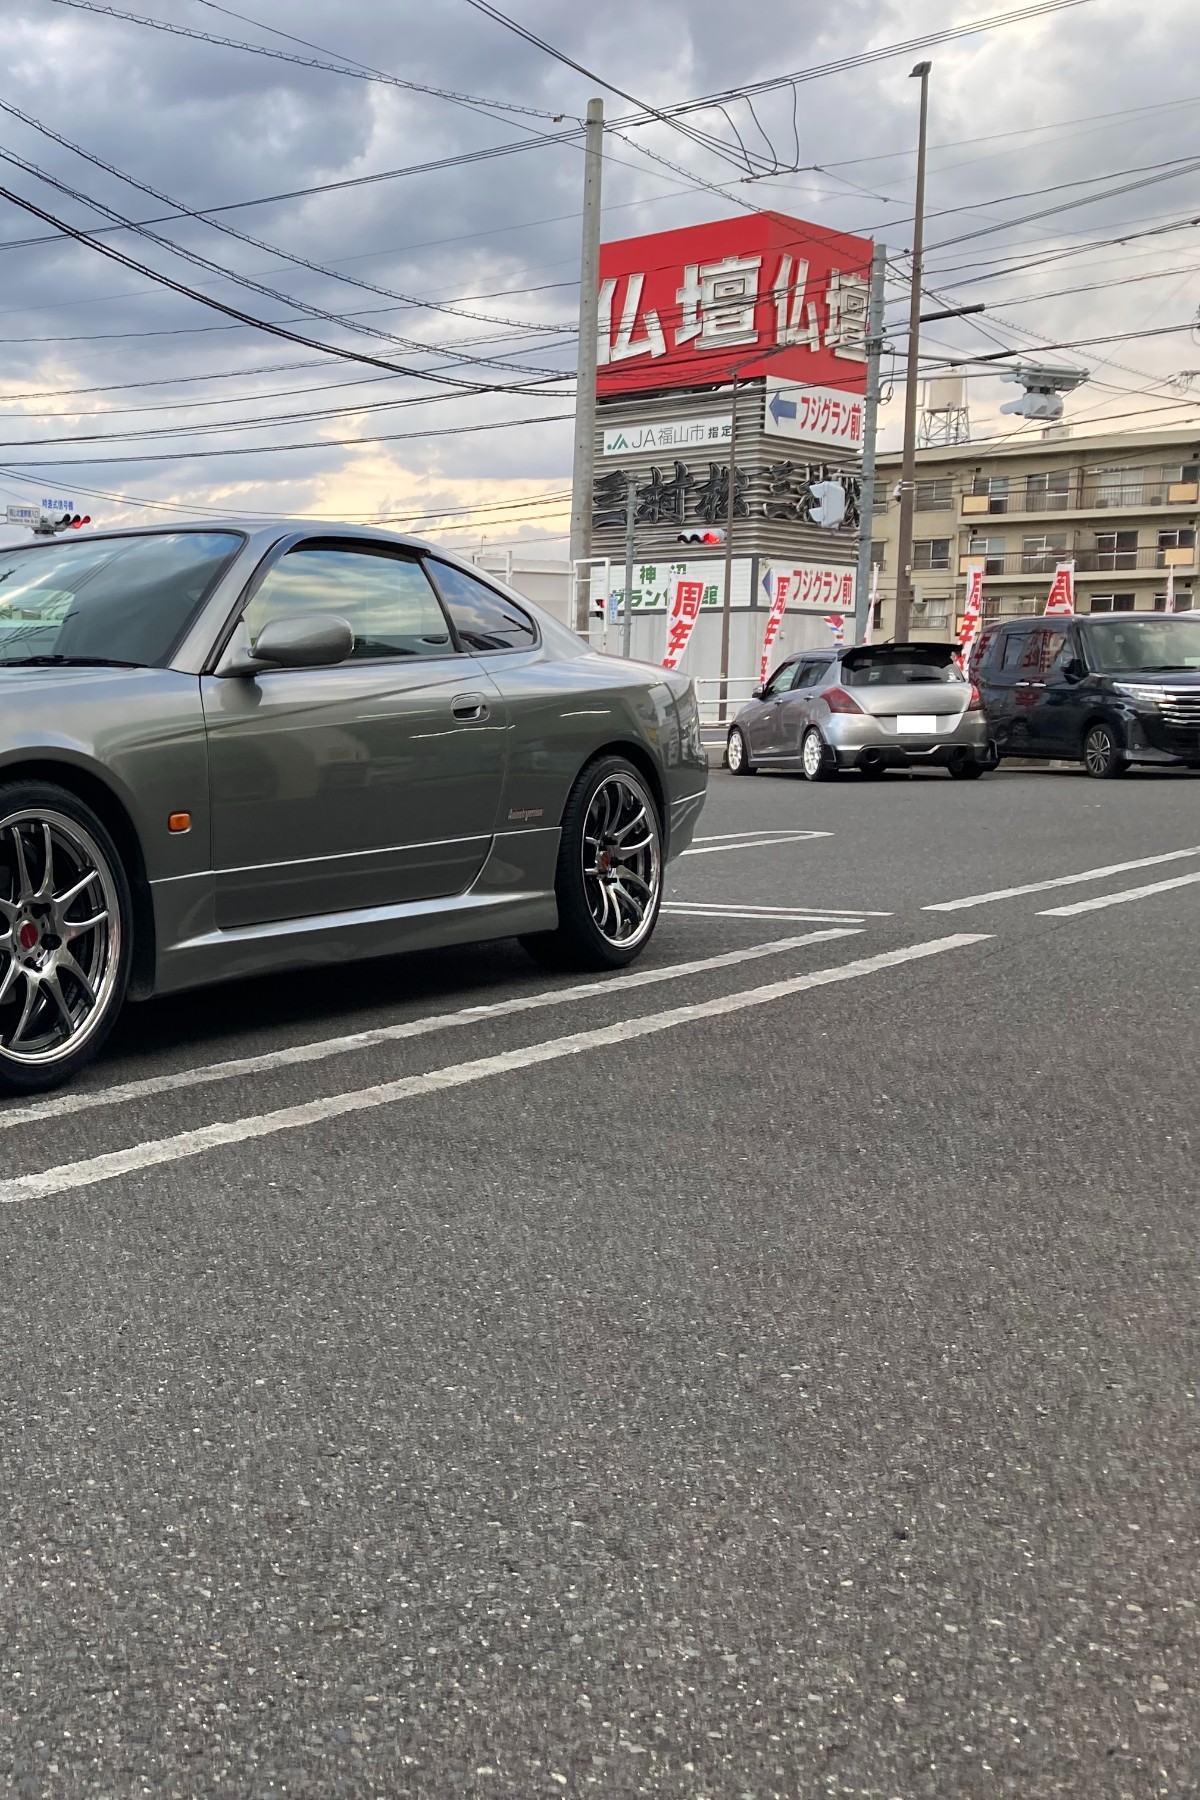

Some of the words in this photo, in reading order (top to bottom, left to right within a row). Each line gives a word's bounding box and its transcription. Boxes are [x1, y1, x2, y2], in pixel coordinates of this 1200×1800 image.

[597, 256, 761, 366] 仏壇
[774, 253, 871, 363] 仏壇
[631, 424, 705, 449] JA福山市
[708, 425, 732, 439] 指定
[801, 396, 862, 442] フジグラン前
[793, 569, 853, 605] フジグラン前
